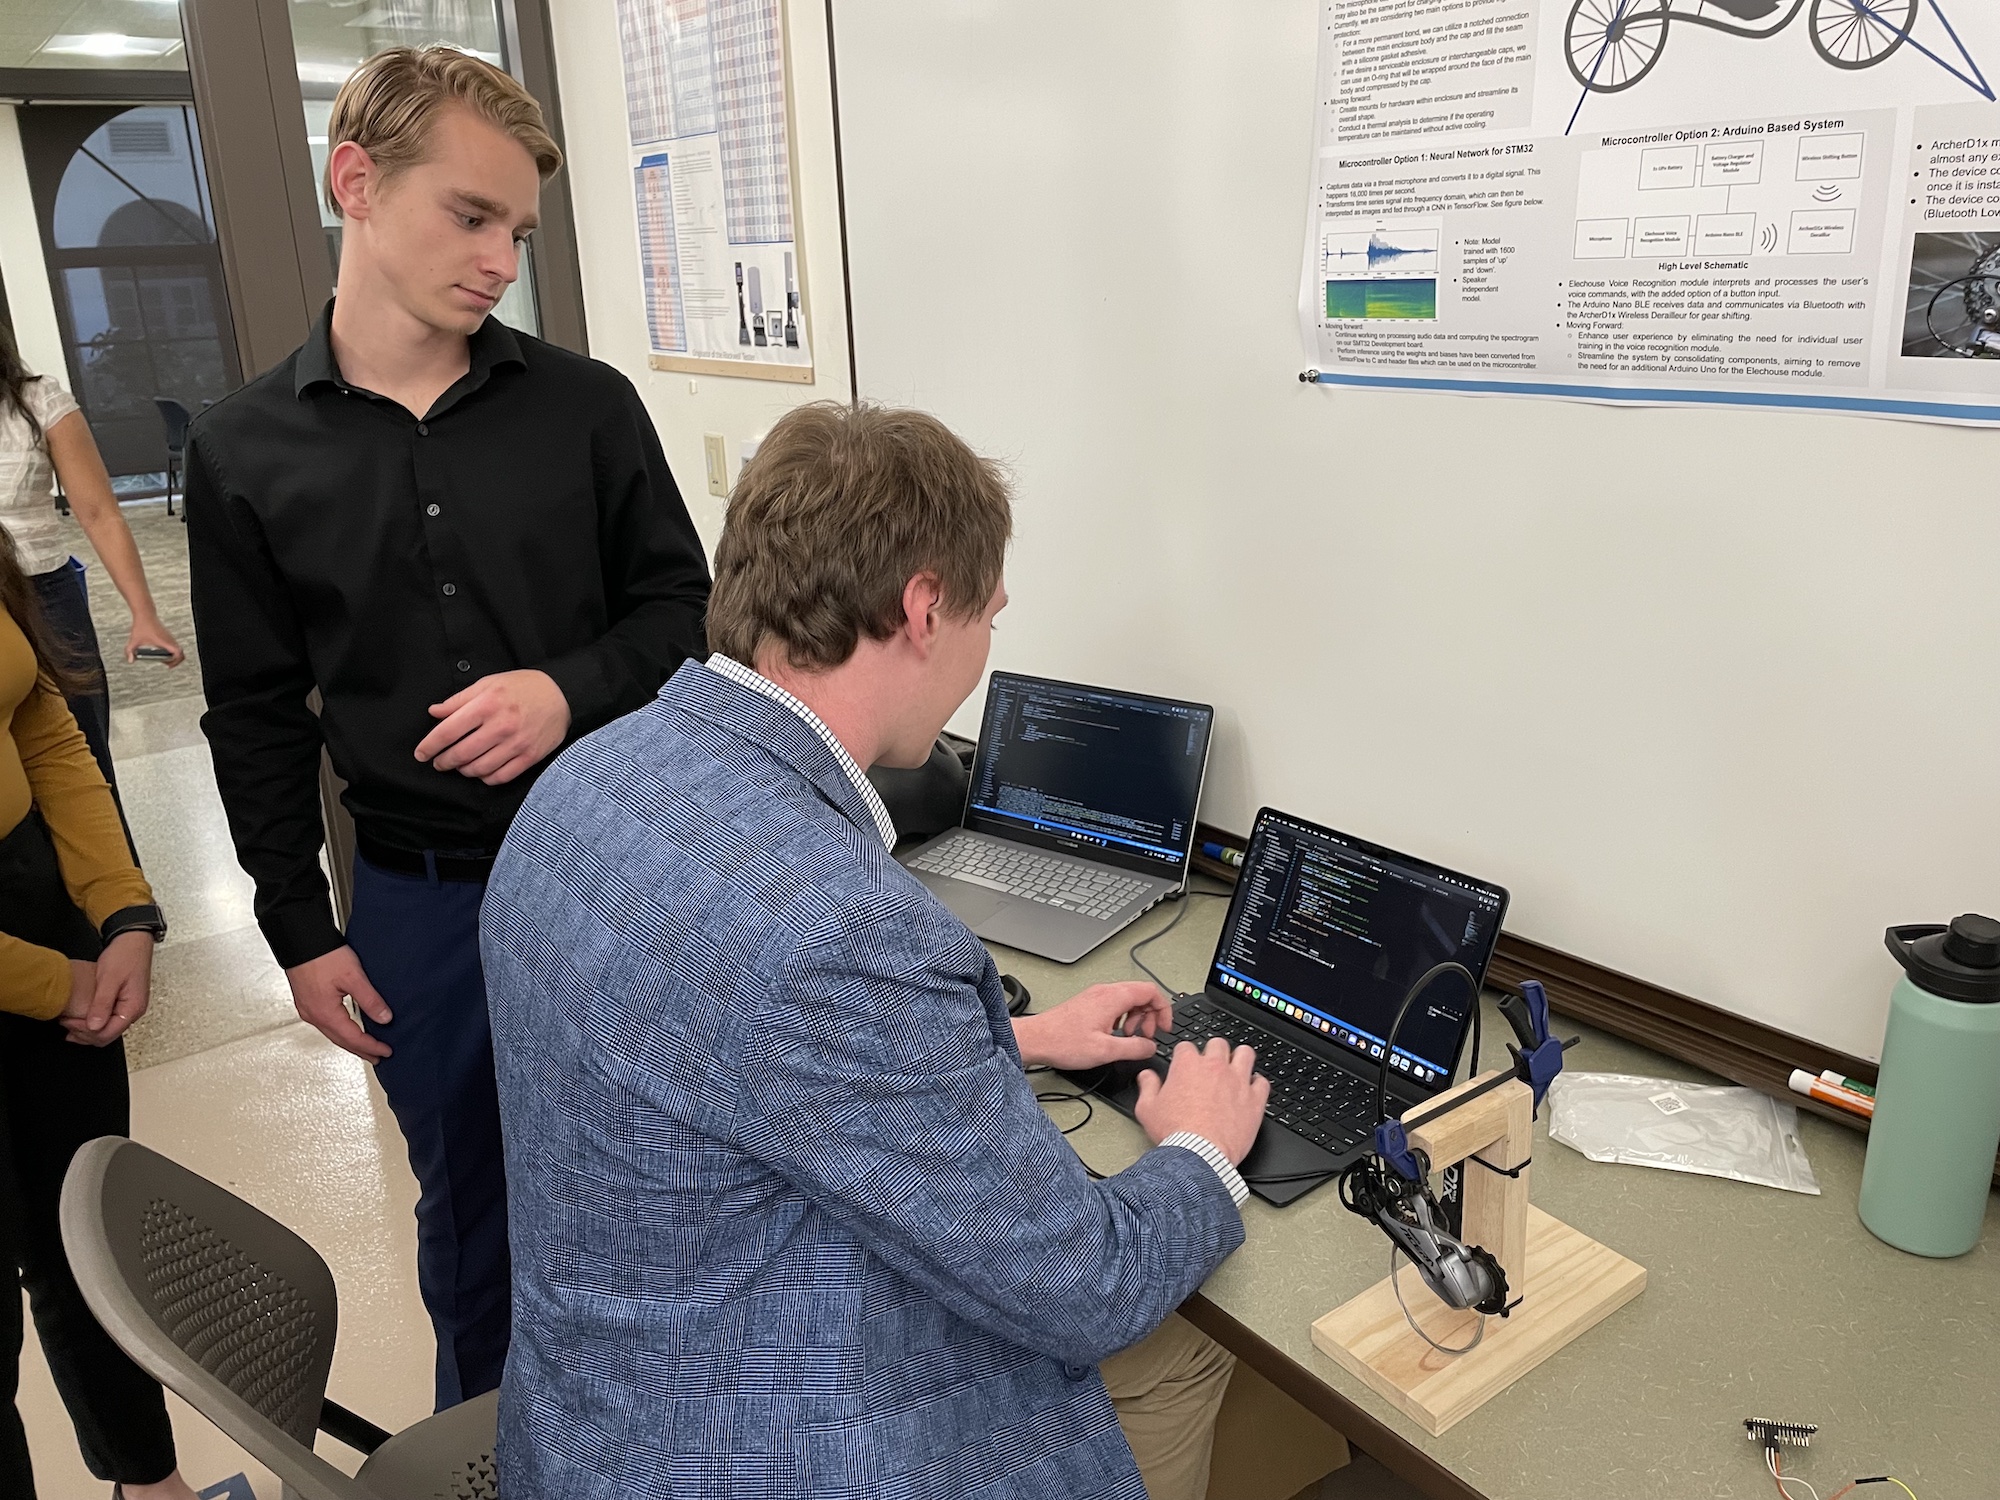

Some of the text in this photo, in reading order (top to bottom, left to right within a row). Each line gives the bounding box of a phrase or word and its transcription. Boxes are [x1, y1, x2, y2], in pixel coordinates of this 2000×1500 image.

[1342, 38, 1352, 46] For
[1373, 30, 1404, 44] permanent
[1444, 21, 1462, 31] utilize
[1469, 17, 1494, 28] notched
[1495, 11, 1530, 24] connection
[1340, 86, 1354, 96] body
[1354, 84, 1365, 93] and
[1366, 80, 1400, 93] compressed
[1409, 78, 1419, 86] the
[1419, 78, 1432, 87] cap.
[1602, 119, 1844, 146] Microcontroller Option 2: Arduino Based System
[1931, 138, 1988, 149] ArcherD1x
[1338, 145, 1533, 168] Microcontroller Option 1: Neural Network for STM32
[1930, 153, 1965, 164] almost
[1968, 154, 1988, 164] any
[1928, 168, 1949, 177] The
[1951, 166, 1987, 177] device
[1326, 181, 1350, 192] Captures
[1351, 180, 1363, 188] data
[1378, 178, 1394, 186] throat
[1394, 176, 1427, 187] microphone
[1428, 175, 1440, 183] and
[1441, 173, 1466, 182] converts
[1485, 171, 1504, 181] digital
[1528, 168, 1541, 176] This
[1926, 183, 1953, 191] once
[1955, 181, 1962, 190] it
[1964, 180, 1974, 190] is
[1924, 195, 1946, 204] The
[1948, 194, 1984, 204] device
[1924, 208, 1978, 220] (Bluetooth
[1486, 246, 1498, 254] with
[1500, 246, 1515, 254] 1600
[1463, 257, 1488, 266] samples
[1658, 261, 1748, 272] High Level Schematic
[1462, 276, 1487, 285] Speaker
[1568, 279, 1606, 287] Elechouse
[1632, 279, 1677, 288] Recognition
[1712, 278, 1751, 288] interprets
[1754, 278, 1771, 286] and
[1462, 285, 1499, 294] independent
[1588, 290, 1629, 299] commands,
[1687, 290, 1711, 299] option
[1758, 290, 1781, 299] input.
[1650, 311, 1687, 319] Derailleur
[1721, 312, 1753, 321] shifting.
[1566, 321, 1591, 330] Moving
[1632, 332, 1673, 342] experience
[1677, 333, 1687, 343] by
[1691, 334, 1734, 343] eliminating
[1738, 334, 1751, 342] the
[1577, 342, 1603, 352] training
[1605, 342, 1612, 350] in
[1647, 343, 1689, 353] recognition
[1690, 344, 1722, 352] module.
[1577, 352, 1614, 360] Streamline
[1632, 353, 1658, 363] system
[1661, 354, 1671, 364] by
[1673, 354, 1725, 365] consolidating
[1727, 356, 1780, 366] components,
[1784, 357, 1812, 367] aiming
[1815, 358, 1824, 366] to
[1590, 362, 1607, 370] need
[1631, 363, 1667, 372] additional
[1668, 365, 1698, 373] Arduino
[1718, 366, 1729, 374] for
[1746, 367, 1789, 376] Elechouse
[1791, 368, 1825, 377] module.
